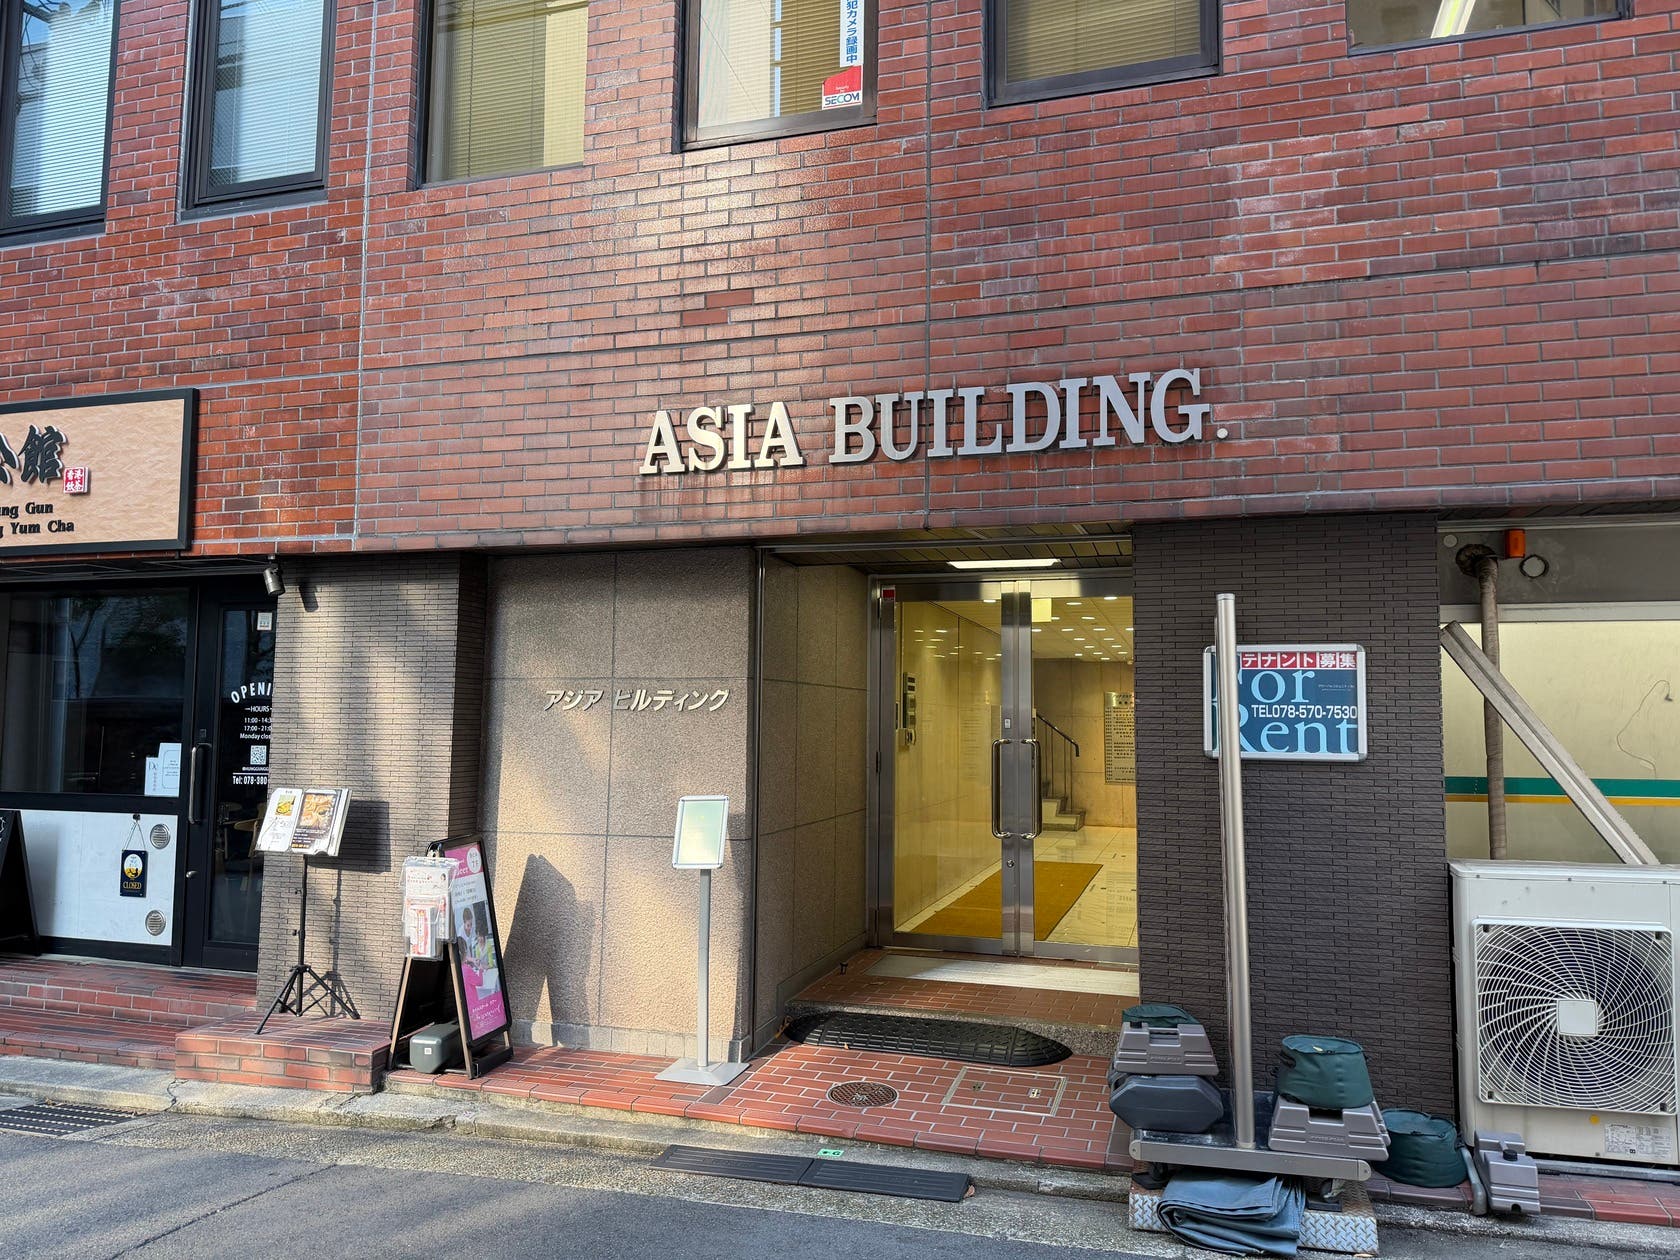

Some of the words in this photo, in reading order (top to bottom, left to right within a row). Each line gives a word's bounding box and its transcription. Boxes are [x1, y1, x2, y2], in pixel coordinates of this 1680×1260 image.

[824, 92, 860, 105] SECOM
[639, 401, 805, 475] ASIA
[0, 506, 19, 519] ng
[25, 502, 54, 514] Gun
[10, 522, 40, 535] Yum
[47, 520, 75, 533] Cha
[1242, 652, 1357, 669] テナント募集
[544, 688, 604, 711] アジア
[613, 688, 730, 712] ビルディング
[1251, 704, 1358, 719] TEL078-570-7530
[240, 732, 260, 741] Monday
